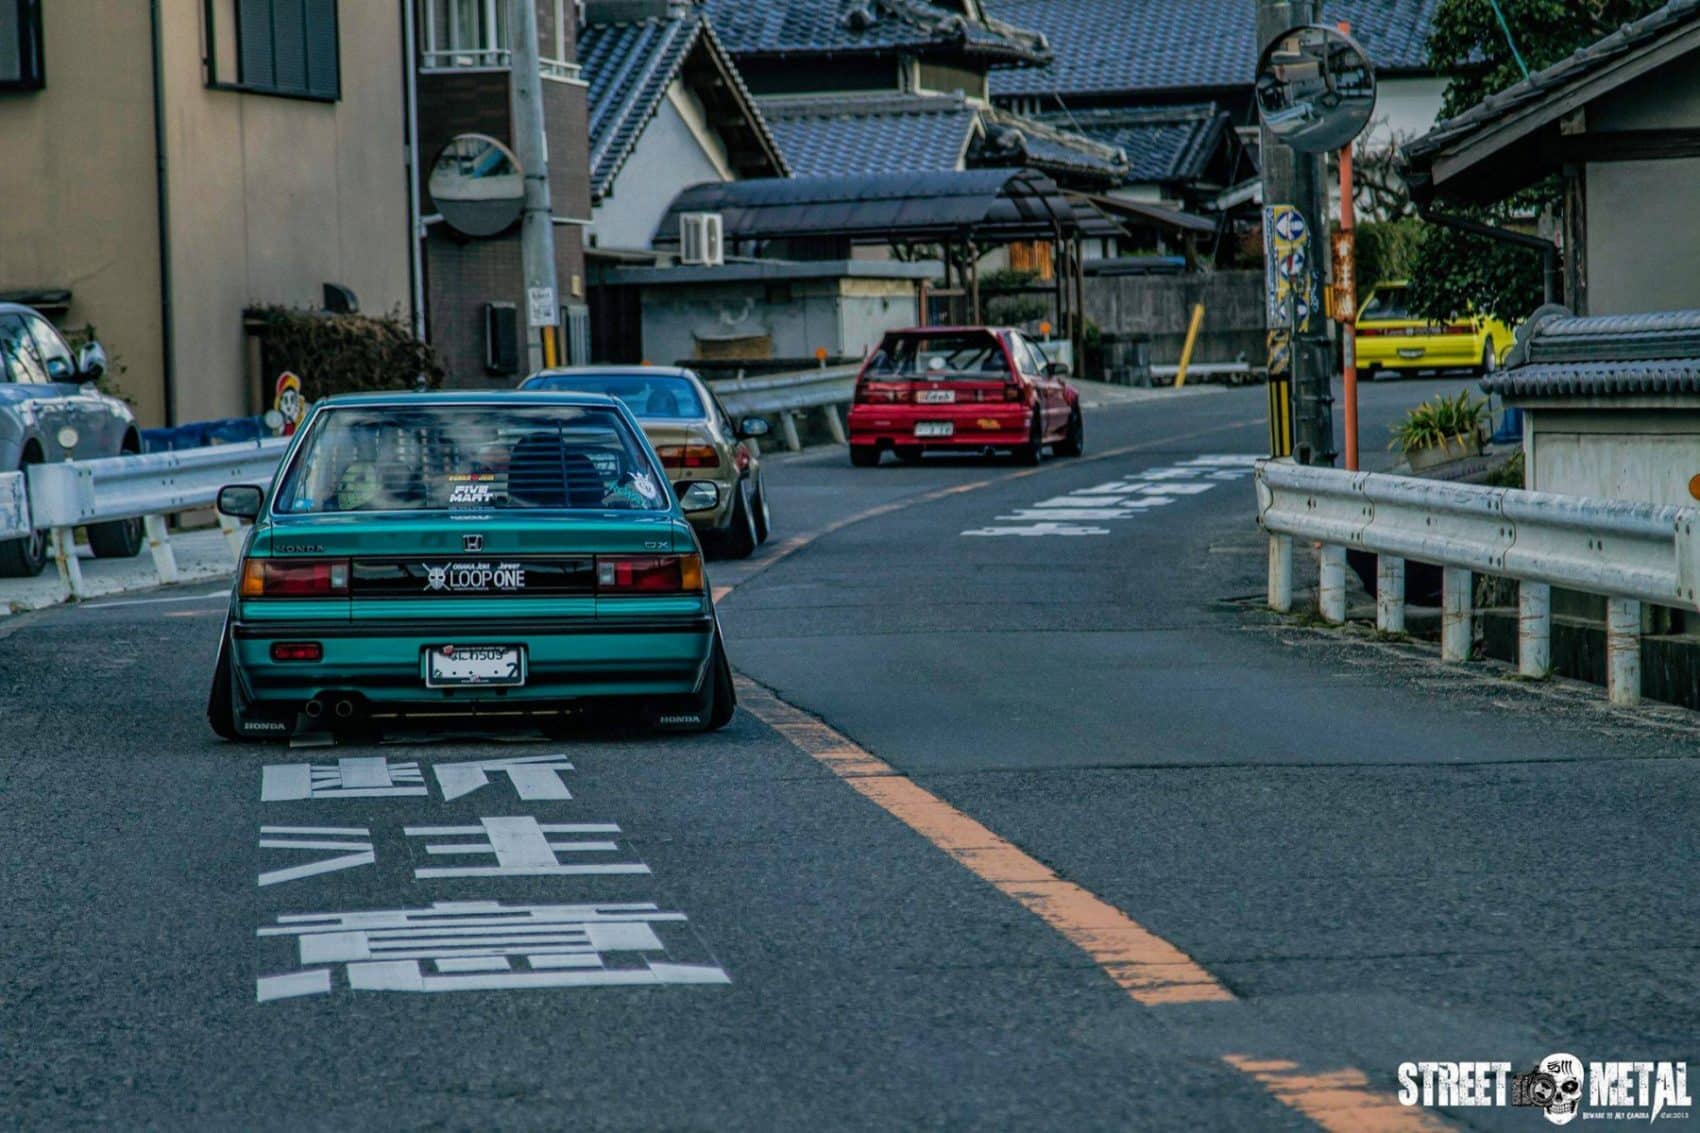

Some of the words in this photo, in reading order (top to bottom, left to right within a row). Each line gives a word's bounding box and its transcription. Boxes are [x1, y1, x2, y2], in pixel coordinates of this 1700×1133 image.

[455, 485, 489, 494] FIVE
[449, 493, 494, 502] MART
[244, 722, 286, 730] HONDA
